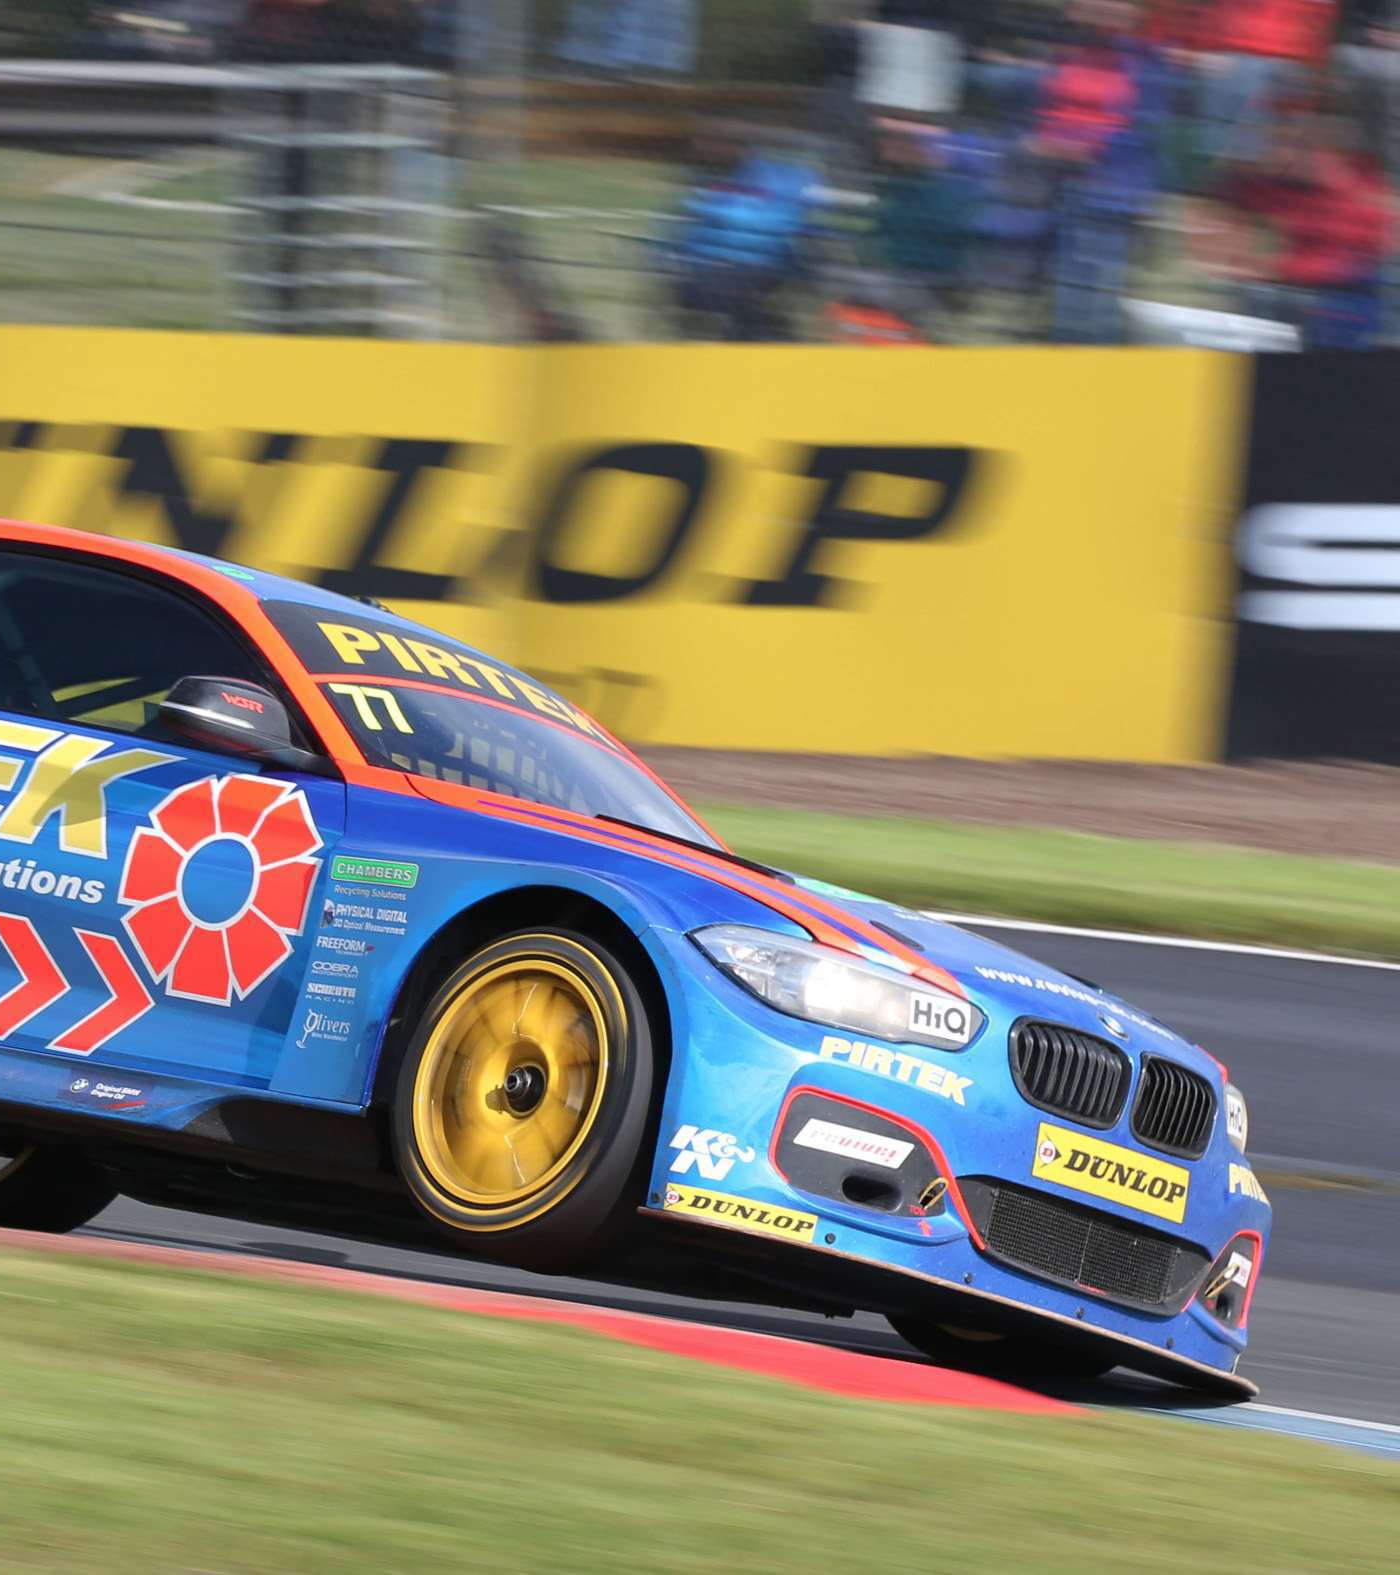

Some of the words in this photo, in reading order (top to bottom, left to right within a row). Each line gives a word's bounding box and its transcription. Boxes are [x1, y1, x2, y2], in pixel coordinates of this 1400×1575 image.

[316, 621, 624, 753] PIRTEK
[328, 682, 414, 734] 77
[337, 863, 412, 881] CHAMBERS
[334, 884, 370, 898] Recycling
[372, 888, 407, 901] Solutions
[335, 903, 374, 919] PHYSICAL
[376, 908, 408, 923] DIGITAL
[316, 936, 366, 952] FREEFORM
[312, 961, 359, 974] COBRA
[913, 999, 966, 1036] HiQ
[819, 1035, 974, 1107] PIRTEK
[1064, 1148, 1185, 1203] DUNLOP
[687, 1194, 815, 1233] DUNLOP
